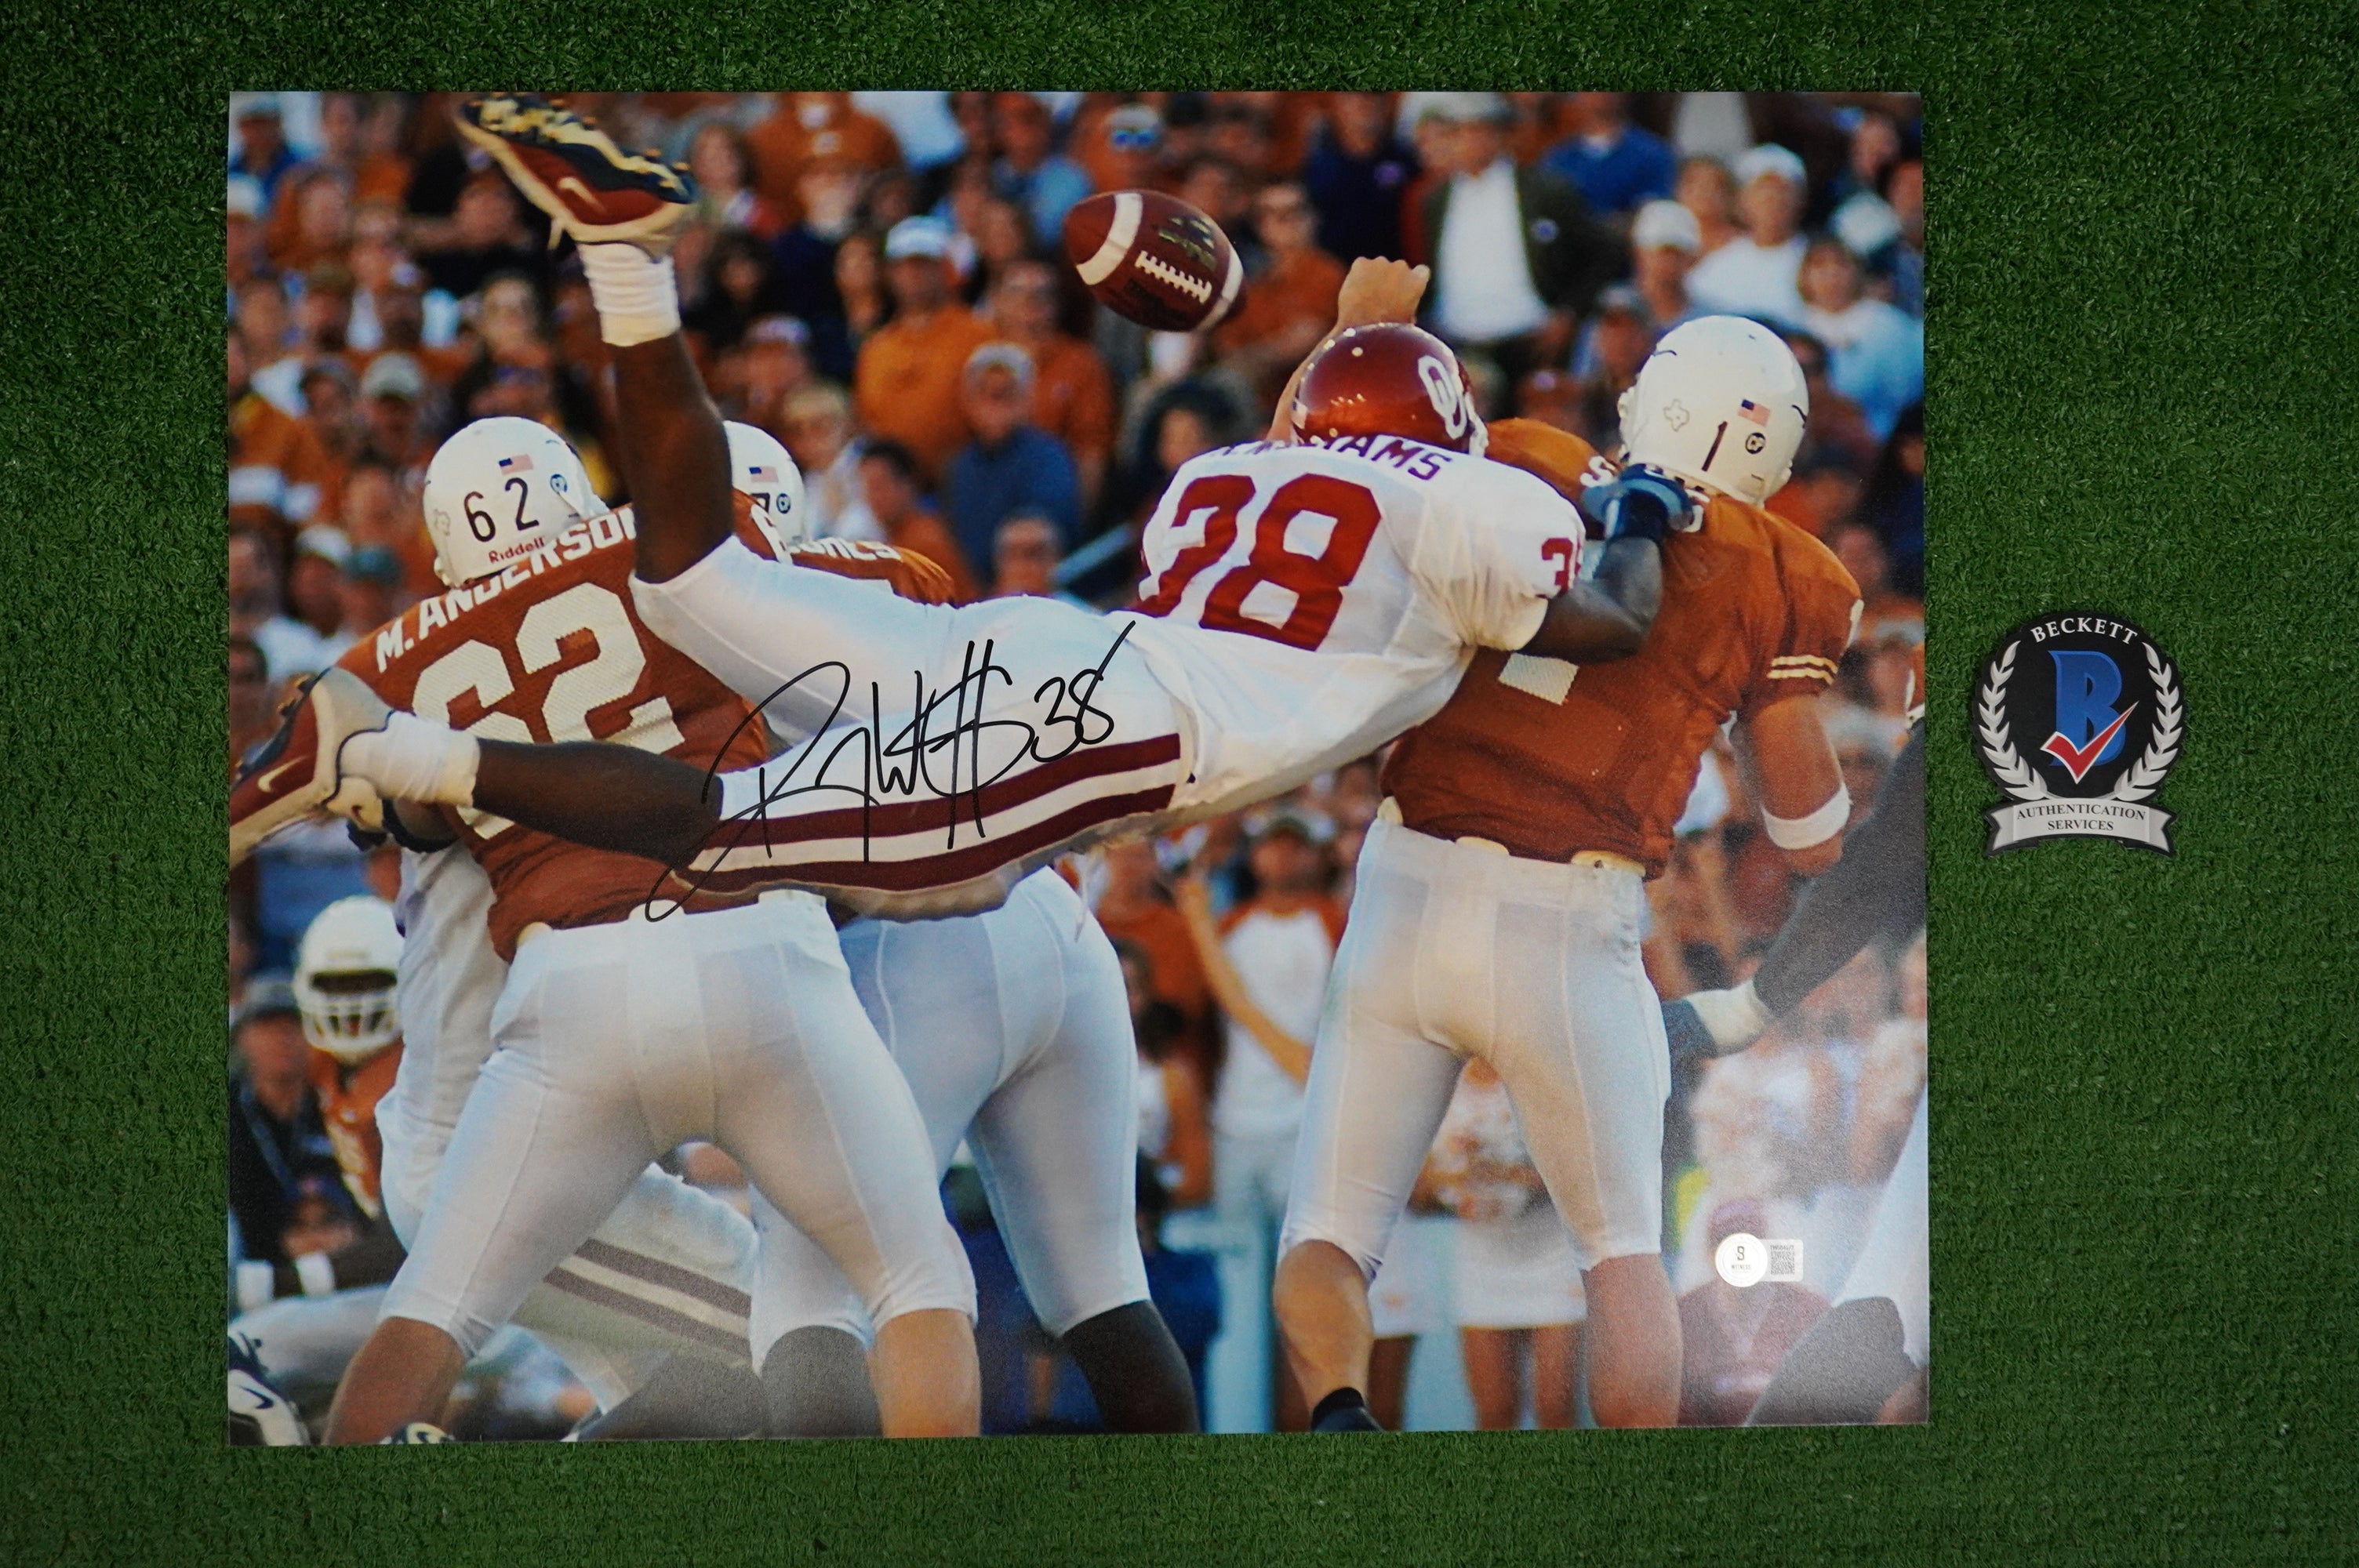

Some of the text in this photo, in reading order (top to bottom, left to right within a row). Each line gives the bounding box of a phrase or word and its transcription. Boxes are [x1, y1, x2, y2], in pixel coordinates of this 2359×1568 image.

[1702, 421, 1728, 472] 1
[488, 537, 547, 564] Riddell
[2030, 617, 2138, 644] BECKETT
[2016, 804, 2146, 821] AUTHENTICATION
[2048, 819, 2114, 832] SERVICES
